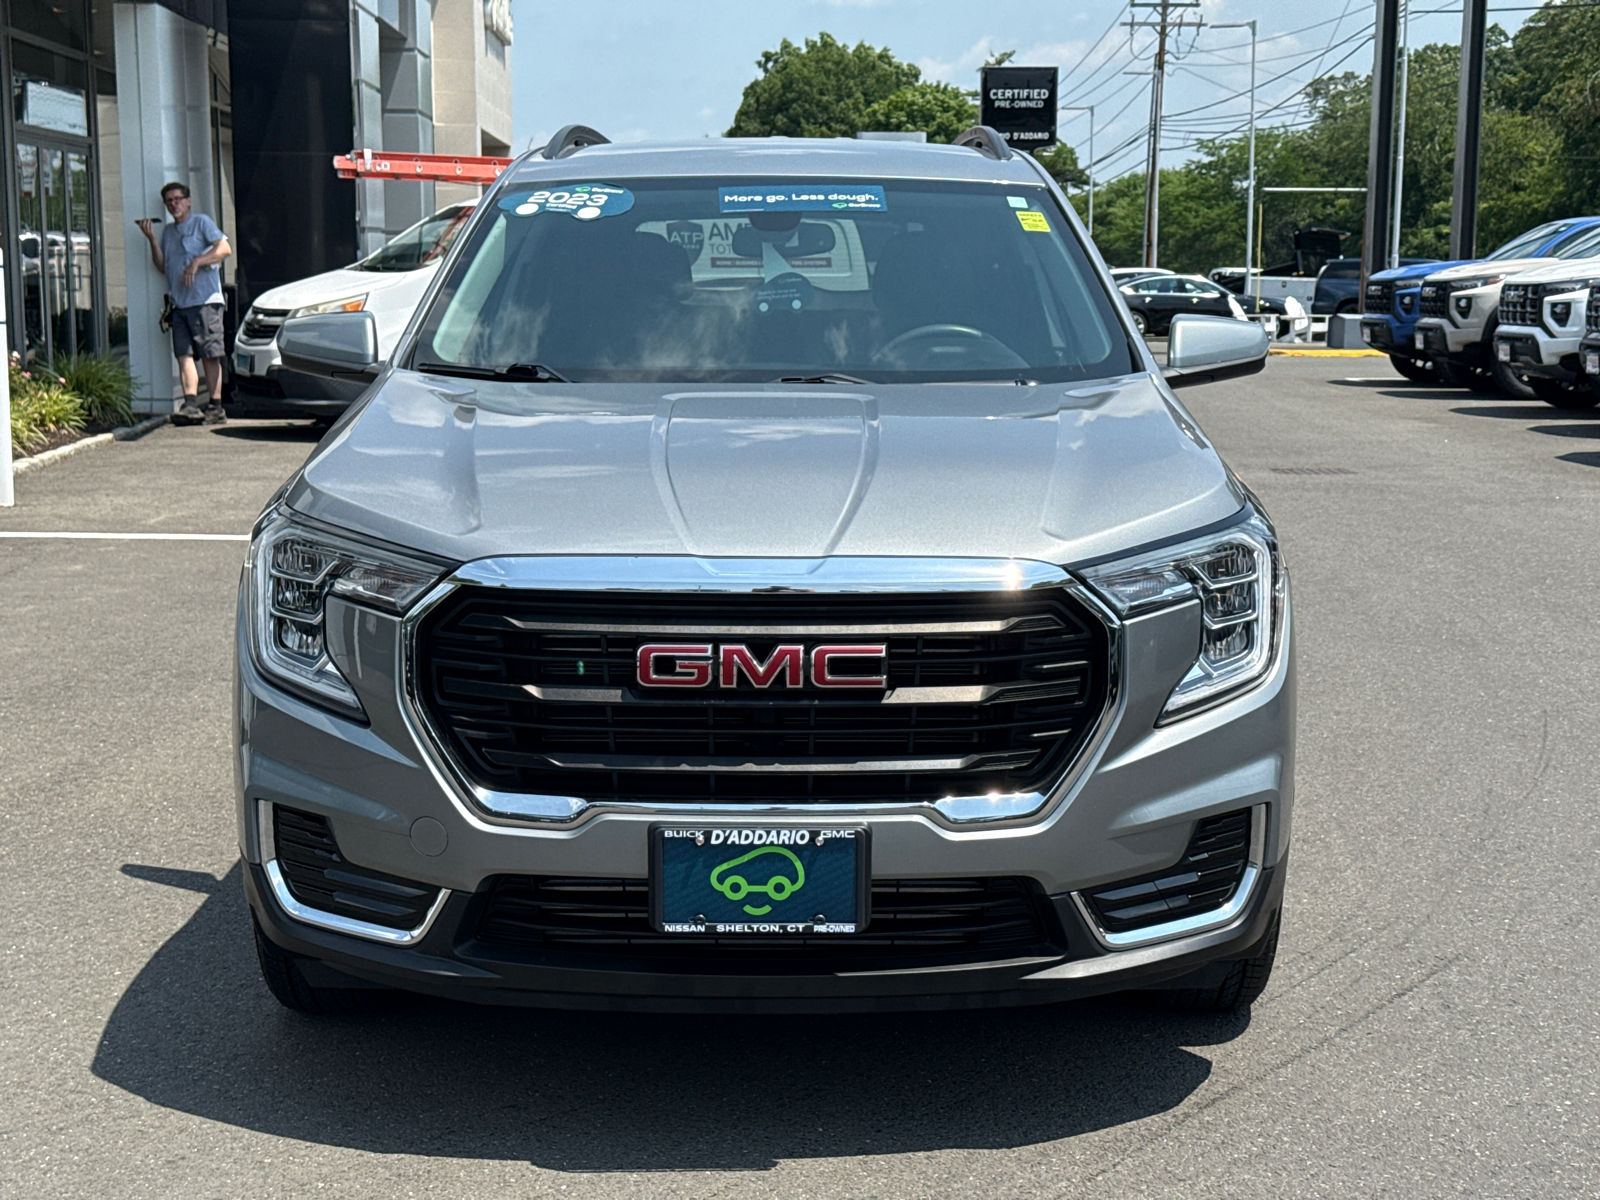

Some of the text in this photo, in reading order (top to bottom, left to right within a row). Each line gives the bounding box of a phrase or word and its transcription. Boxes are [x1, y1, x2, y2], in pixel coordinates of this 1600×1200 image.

[989, 88, 1050, 100] CERTIFIED
[994, 100, 1045, 109] PRE-OWNED
[527, 190, 608, 206] 2023
[724, 193, 879, 203] More go. Less dough.
[670, 231, 704, 244] ATP
[636, 642, 889, 689] GMC
[664, 830, 705, 838] BUICK
[710, 829, 810, 845] D'ADDARIO
[820, 830, 856, 839] GMC
[664, 924, 706, 933] NISSAN
[716, 924, 806, 934] SHELTON, CT
[813, 924, 856, 933] PRE-OWNED
